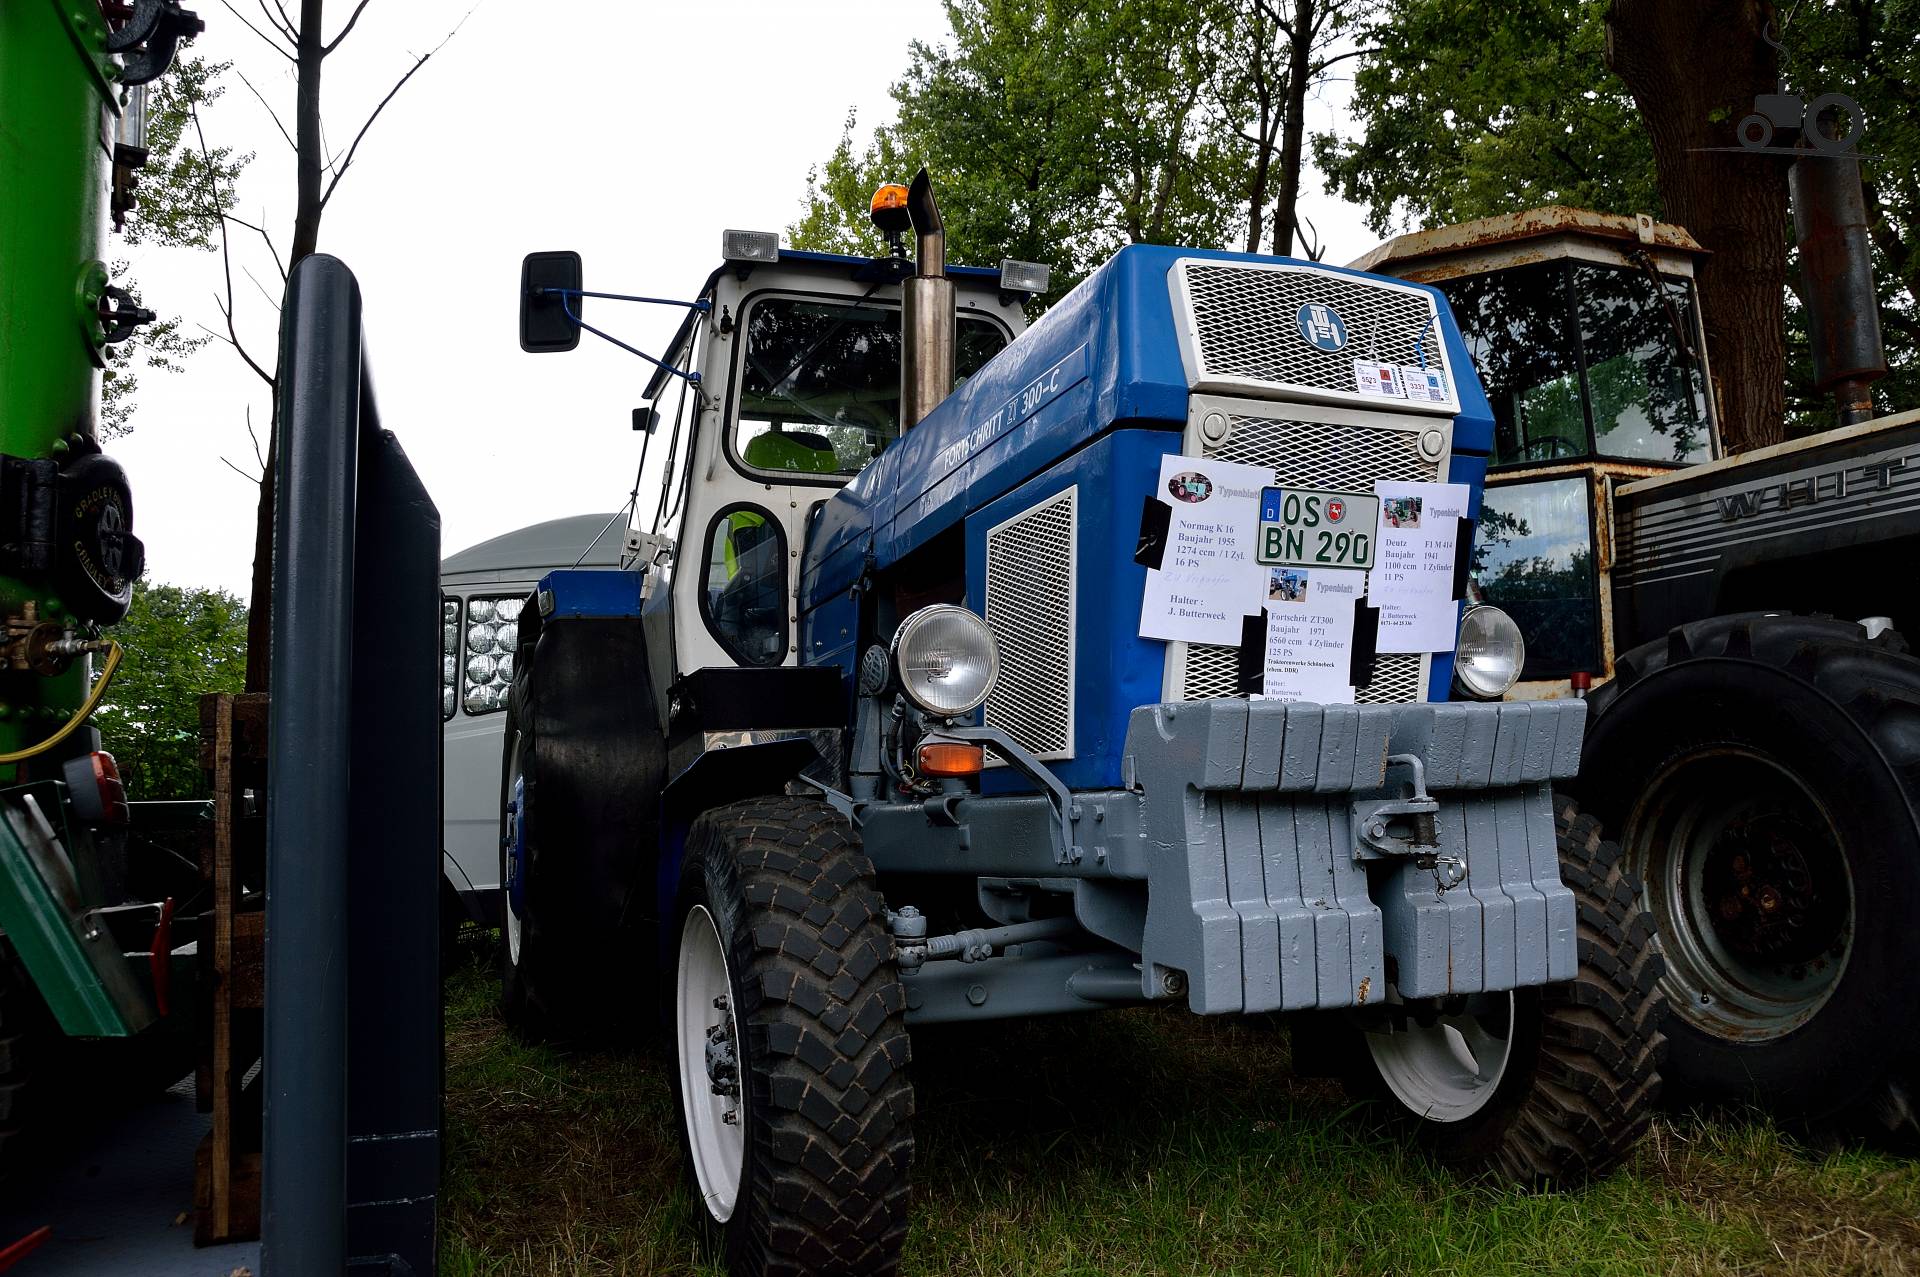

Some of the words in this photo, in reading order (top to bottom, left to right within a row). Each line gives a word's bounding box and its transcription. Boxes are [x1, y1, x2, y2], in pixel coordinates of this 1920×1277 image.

[944, 409, 1004, 470] FORTSCHRITT
[1021, 368, 1060, 415] 300-C
[1266, 508, 1274, 518] D
[1284, 493, 1320, 527] OS
[1430, 507, 1459, 518] Typenblatt
[1180, 520, 1214, 533] Normag
[1216, 524, 1224, 532] K
[1226, 525, 1235, 534] 16
[1178, 533, 1213, 546] Baujahr
[1218, 537, 1235, 546] 1955
[1386, 539, 1407, 547] Deutz
[1265, 527, 1304, 560] BN
[1316, 531, 1368, 564] 290
[1177, 546, 1197, 555] 1274
[1199, 548, 1216, 557] ccm
[1385, 551, 1415, 559] Baujahr
[1175, 557, 1186, 566] 16
[1188, 559, 1200, 568] PS
[1385, 562, 1401, 570] 1100
[1429, 564, 1453, 572] Zylinder
[1317, 582, 1353, 593] Typenblatt
[1170, 594, 1199, 606] Halter
[1168, 607, 1176, 616] J.
[1179, 608, 1226, 621] Butterweck
[1271, 612, 1307, 623] Fortschrit
[1310, 616, 1334, 624] ZT300
[1270, 625, 1300, 635] Baujahr
[1309, 628, 1325, 636] 1971
[1314, 640, 1344, 649] Zylinder
[1283, 649, 1293, 657] PS
